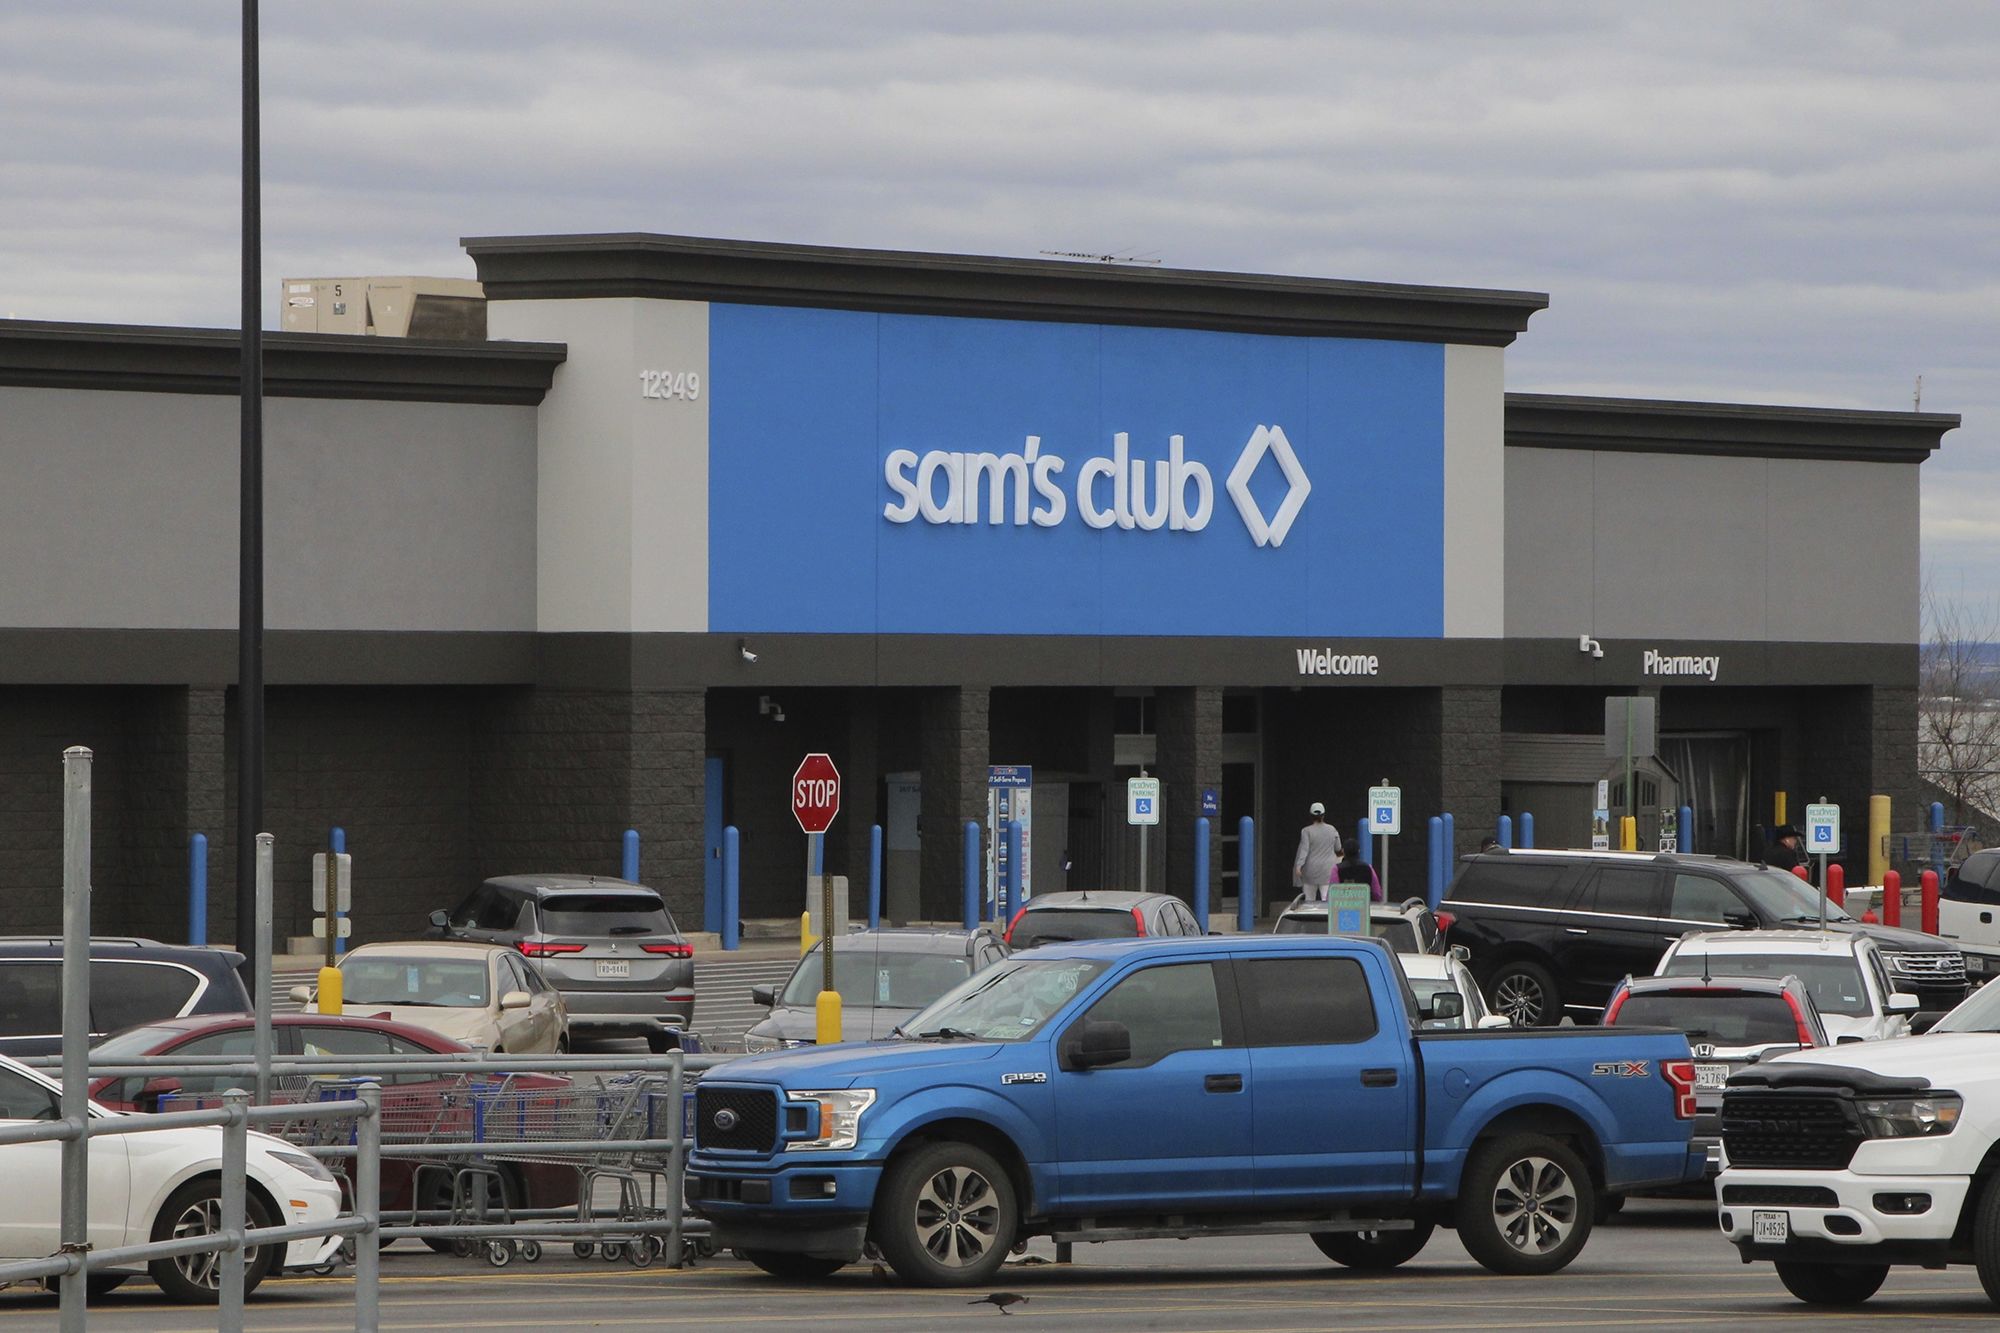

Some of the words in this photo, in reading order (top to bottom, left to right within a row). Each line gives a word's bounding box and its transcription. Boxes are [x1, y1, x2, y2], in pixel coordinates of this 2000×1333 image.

[335, 284, 342, 297] 5
[640, 369, 700, 400] 12349
[883, 435, 1067, 527] sam's
[1077, 432, 1214, 532] club
[1296, 647, 1379, 675] Welcome
[1643, 649, 1720, 681] Pharmacy
[796, 779, 837, 808] STOP
[1591, 1060, 1651, 1078] STX
